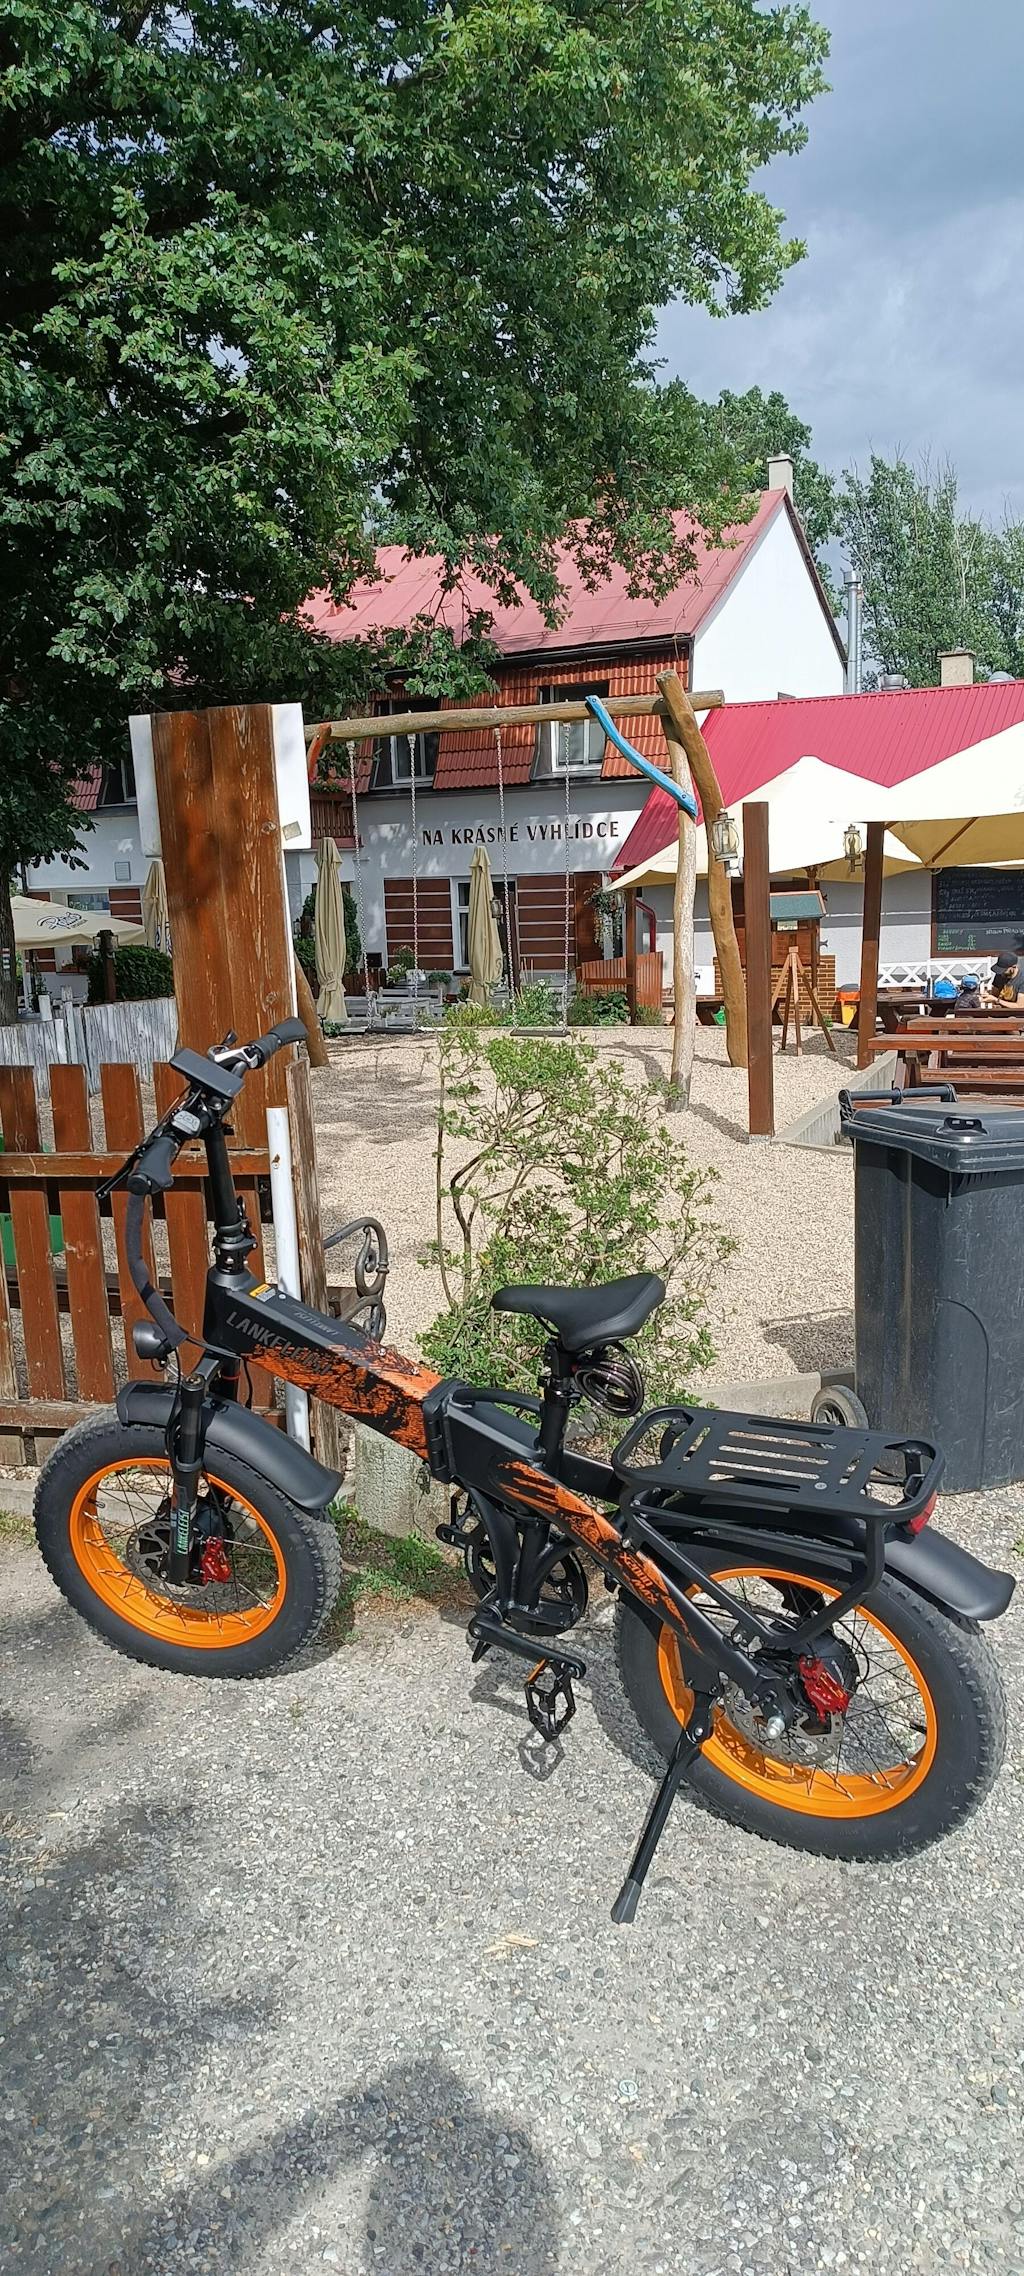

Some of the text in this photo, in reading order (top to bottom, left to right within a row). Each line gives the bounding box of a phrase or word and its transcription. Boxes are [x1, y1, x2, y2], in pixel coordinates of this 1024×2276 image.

[422, 819, 619, 846] NA KRÁSNÉ VYHLÍDCE
